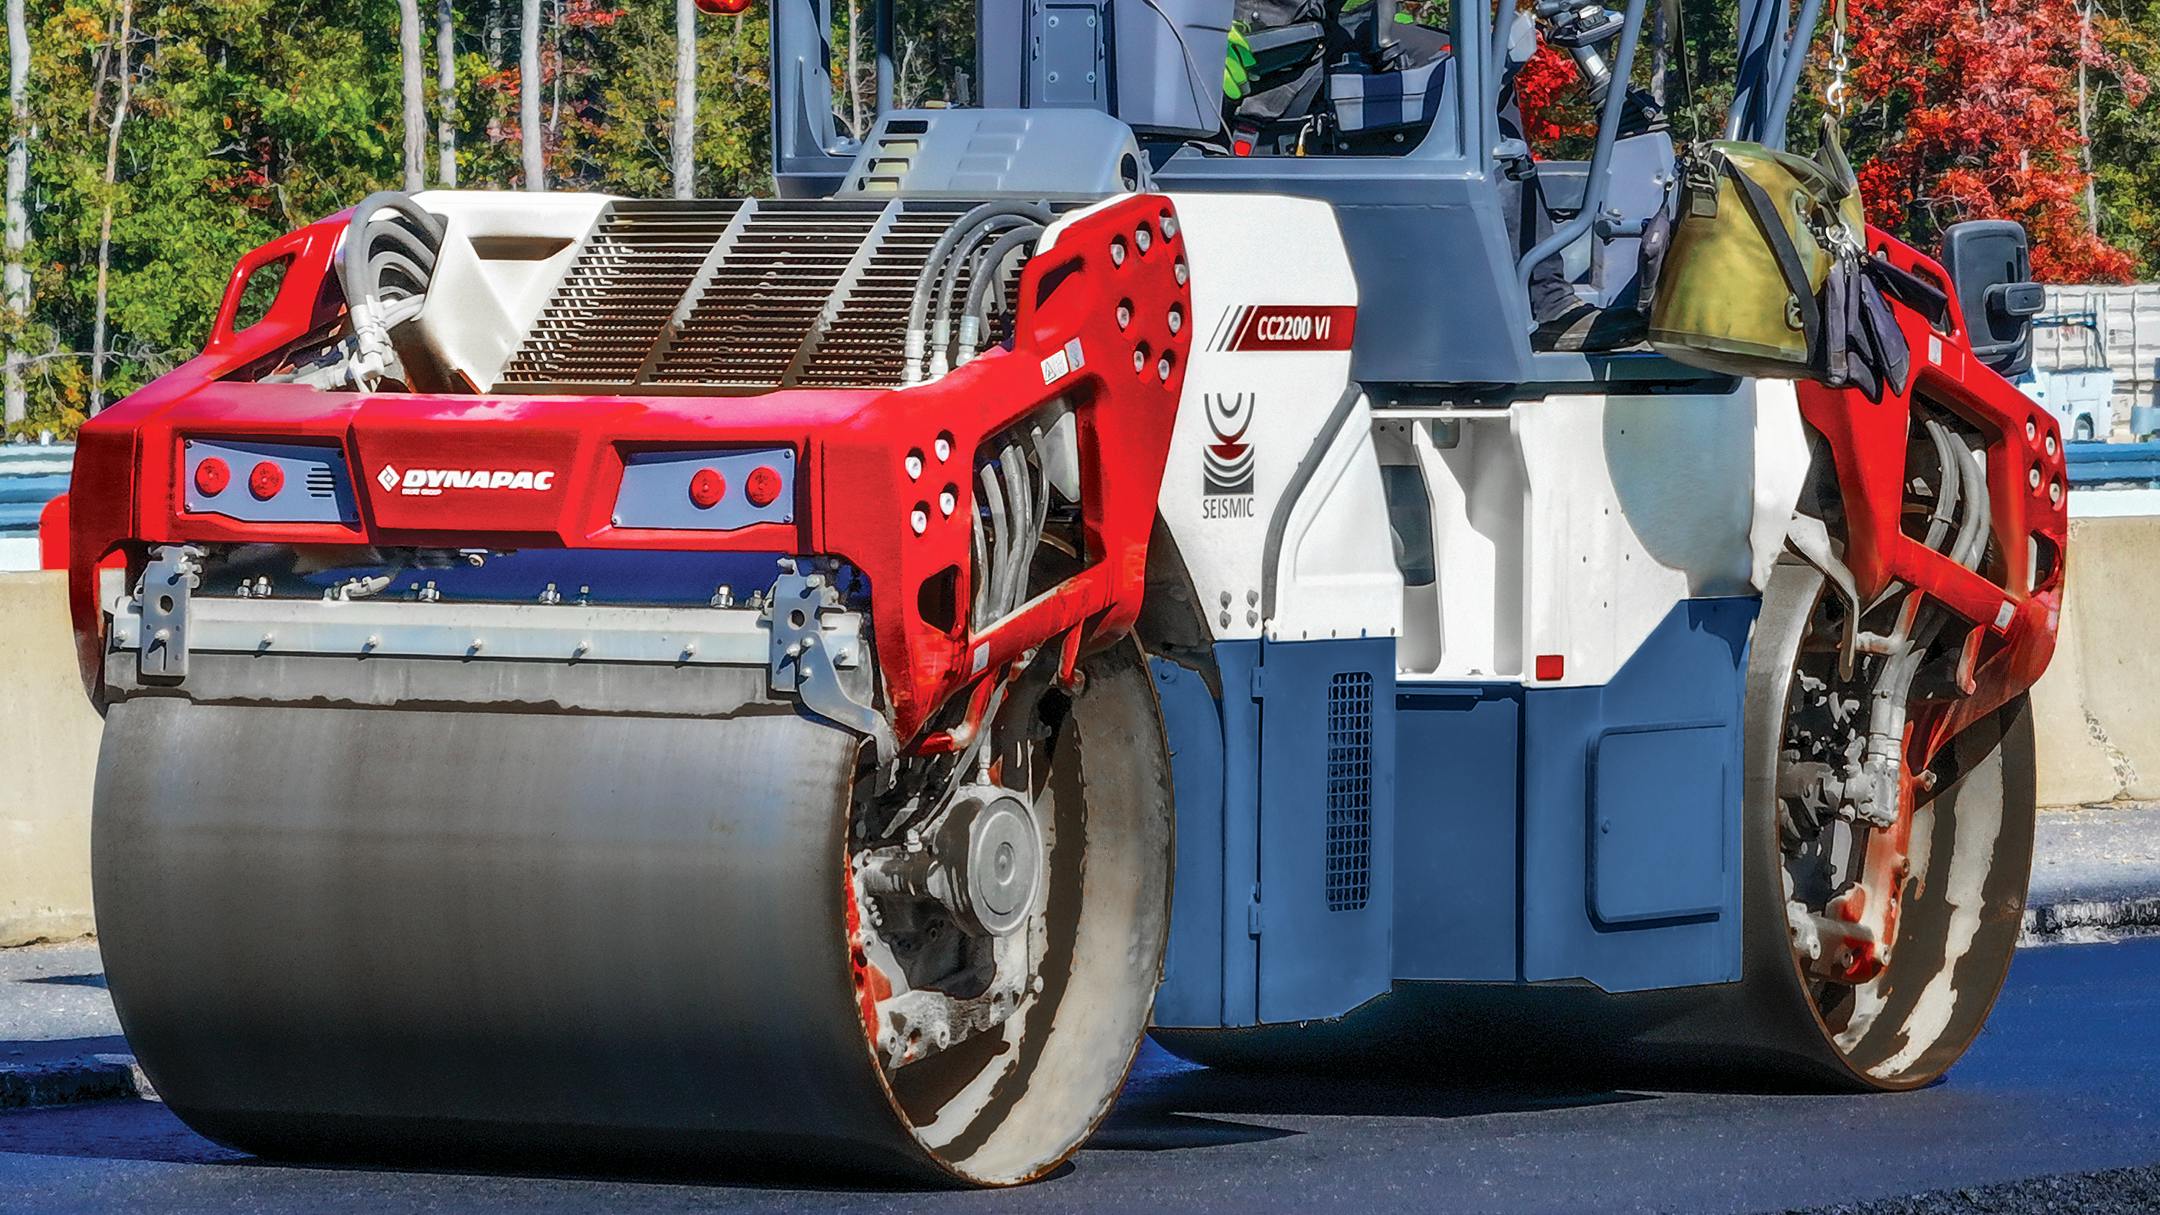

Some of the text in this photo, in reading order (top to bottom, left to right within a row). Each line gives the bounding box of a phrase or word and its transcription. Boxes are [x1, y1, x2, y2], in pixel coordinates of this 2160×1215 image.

[1257, 315, 1332, 341] CC2200 VI
[402, 469, 555, 491] DYNAPAC
[1202, 497, 1255, 520] SEISMIC
